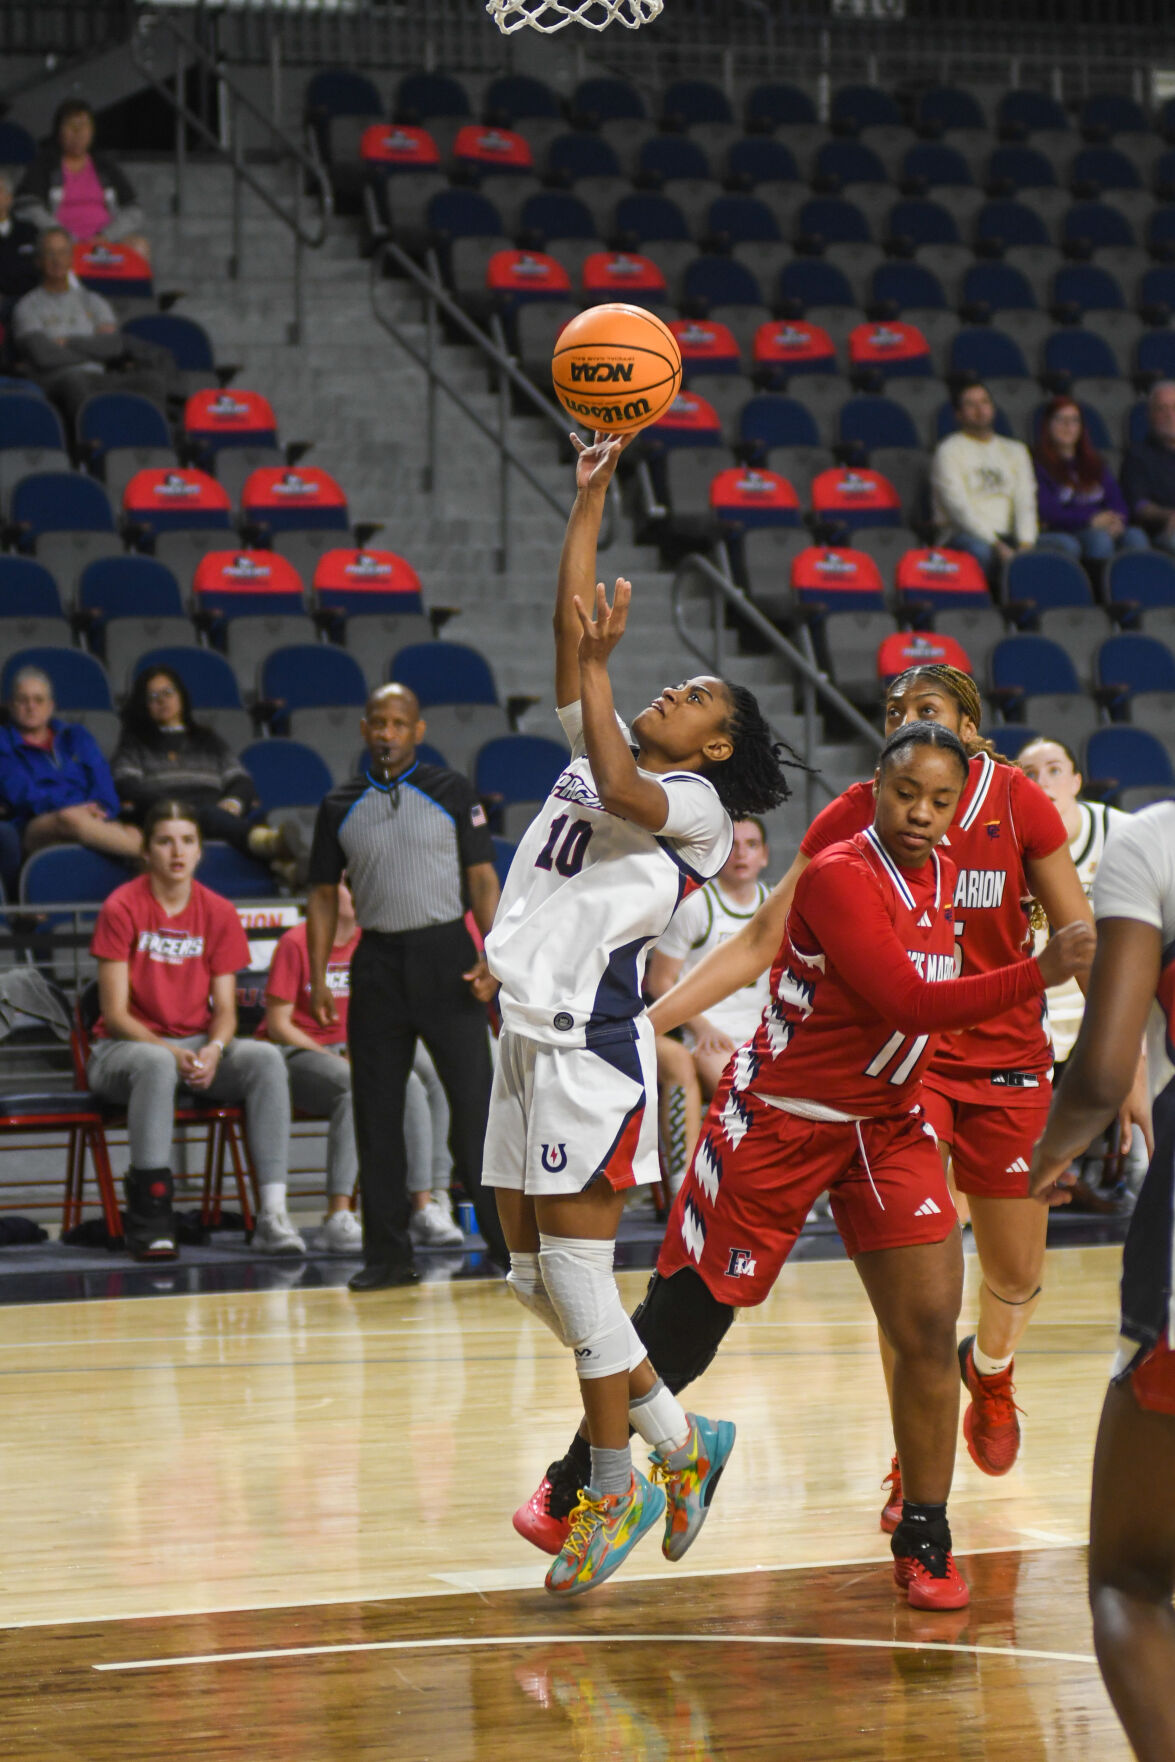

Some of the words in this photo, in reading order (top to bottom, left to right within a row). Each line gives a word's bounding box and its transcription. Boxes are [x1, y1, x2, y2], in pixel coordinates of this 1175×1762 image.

[570, 361, 634, 382] NCAA
[564, 397, 652, 423] Wilson
[535, 814, 593, 878] 10
[953, 868, 1006, 909] ARION
[138, 931, 204, 957] PACERS
[863, 1030, 930, 1085] 11
